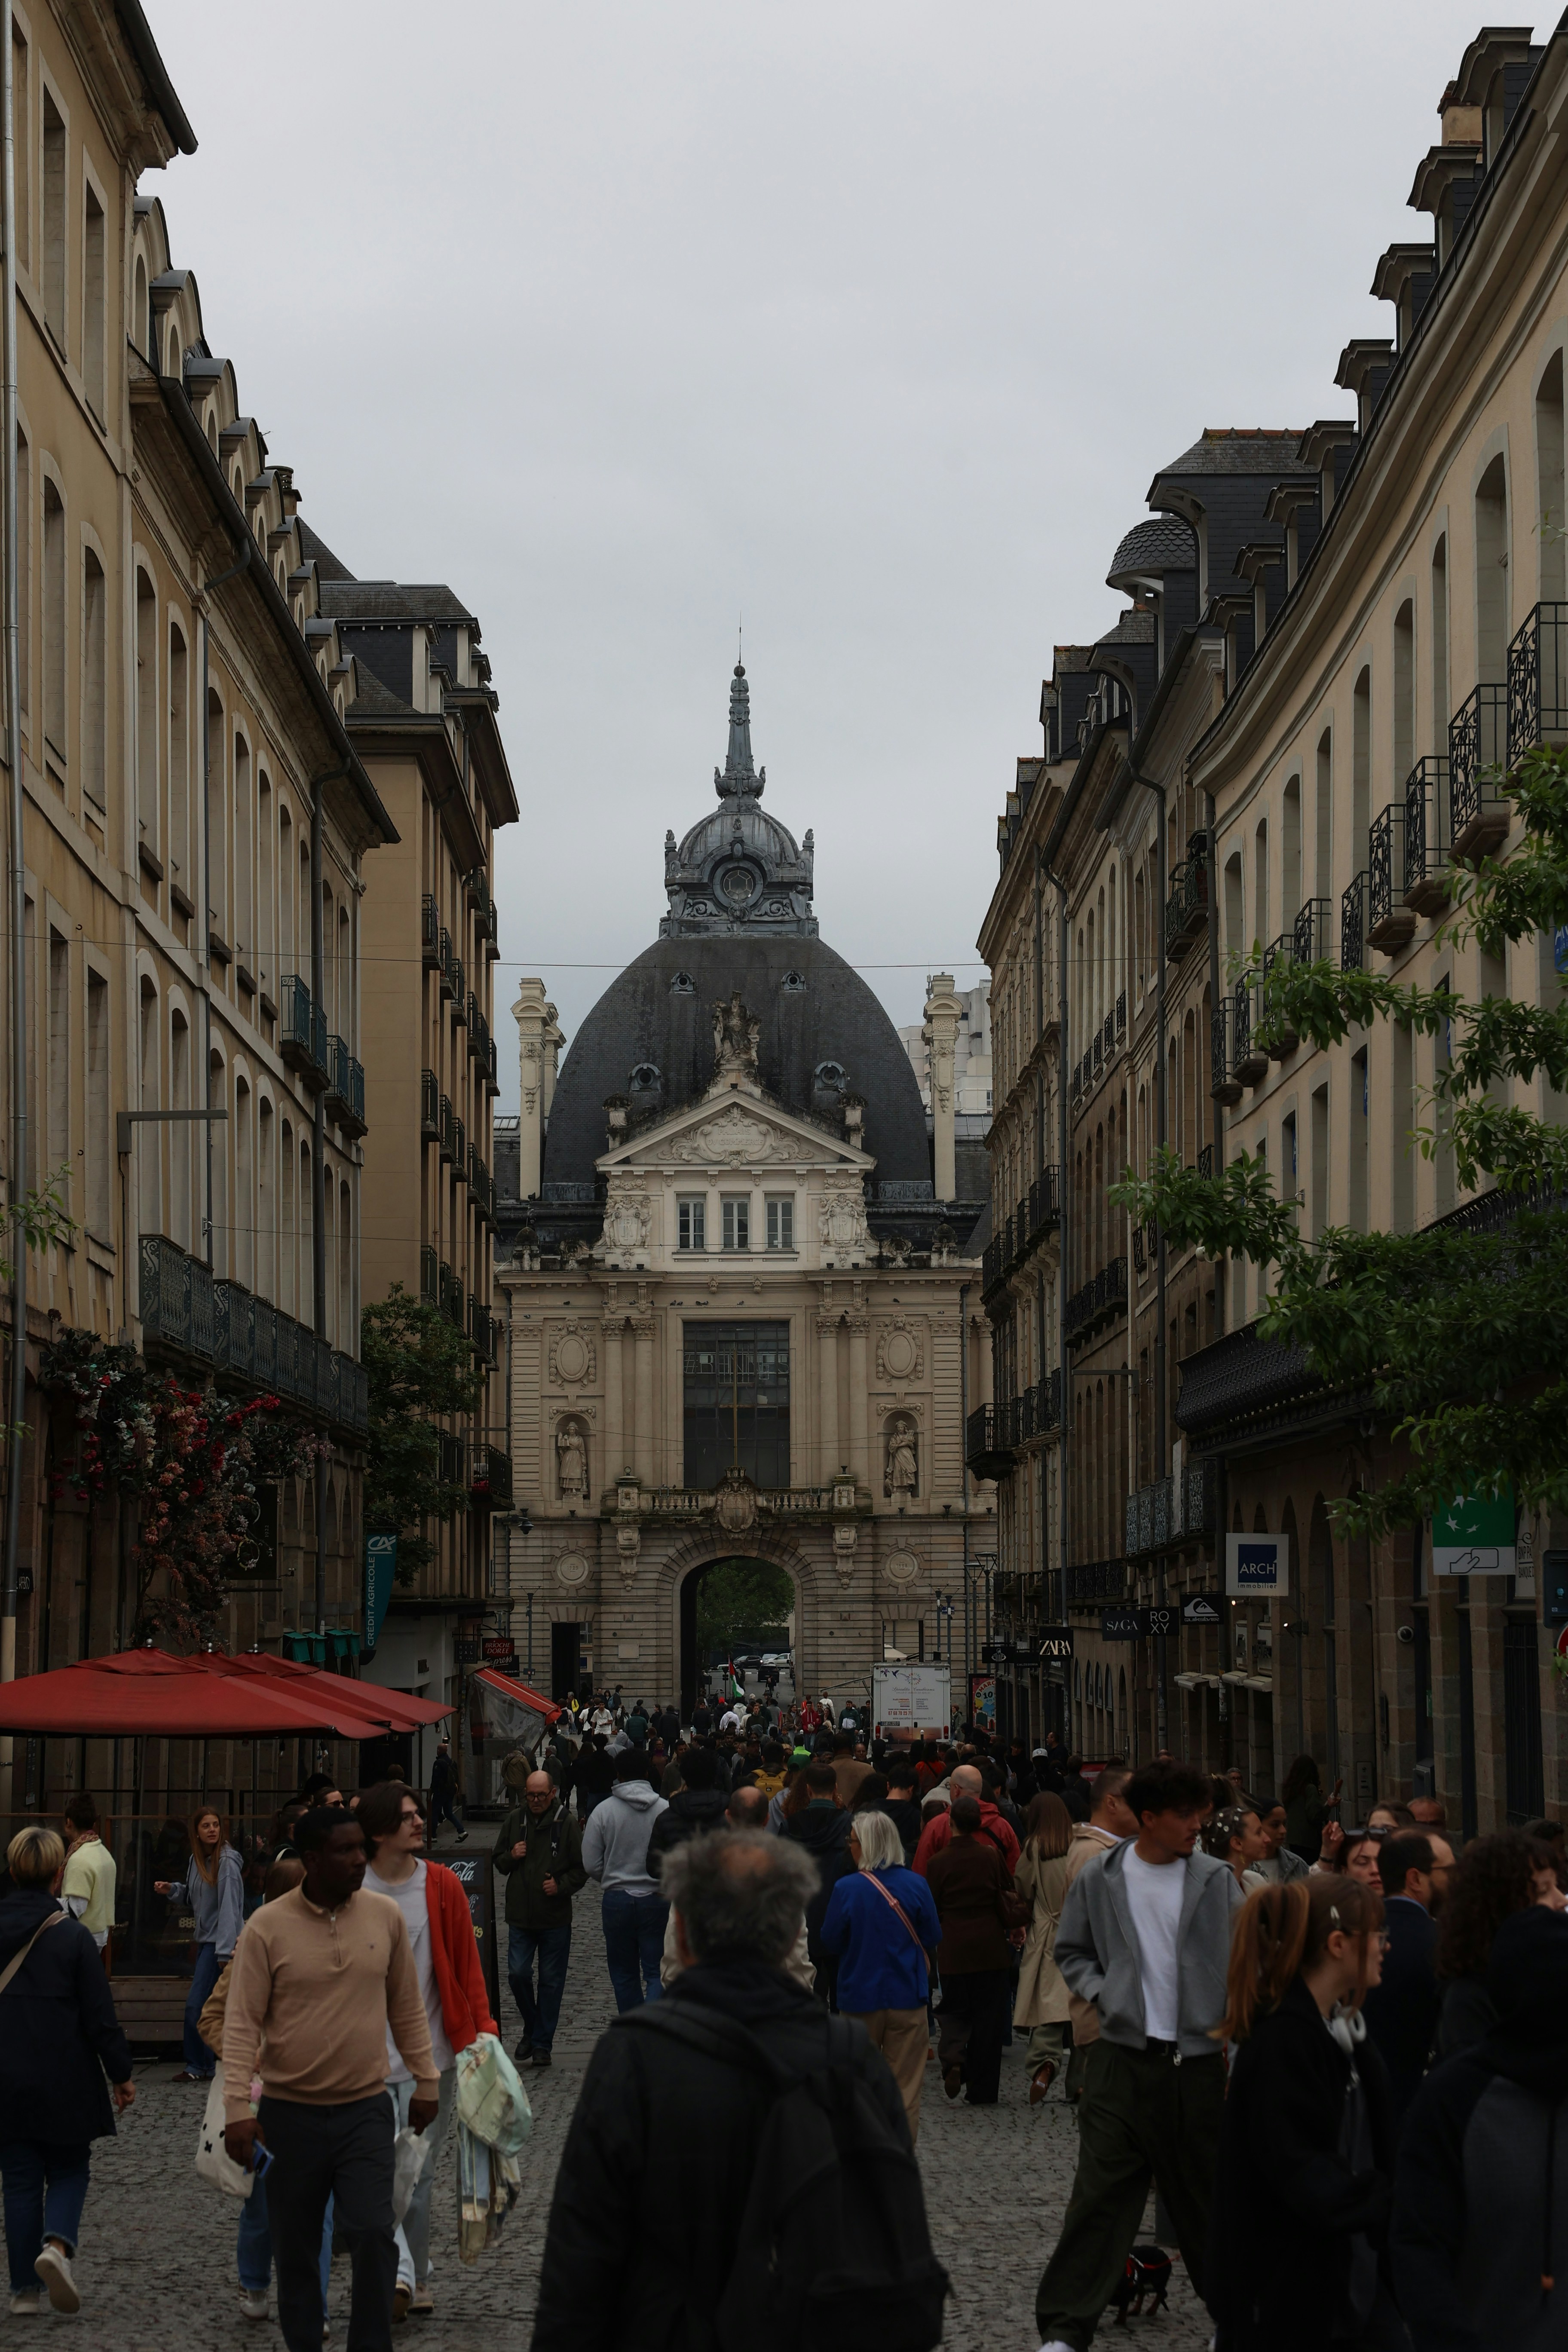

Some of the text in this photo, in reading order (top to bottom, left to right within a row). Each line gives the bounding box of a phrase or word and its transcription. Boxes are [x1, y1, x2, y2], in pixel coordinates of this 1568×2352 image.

[367, 1609, 375, 1646] CRÉDIT
[1106, 1619, 1138, 1631] SAGA
[1039, 1640, 1071, 1655] ZARA
